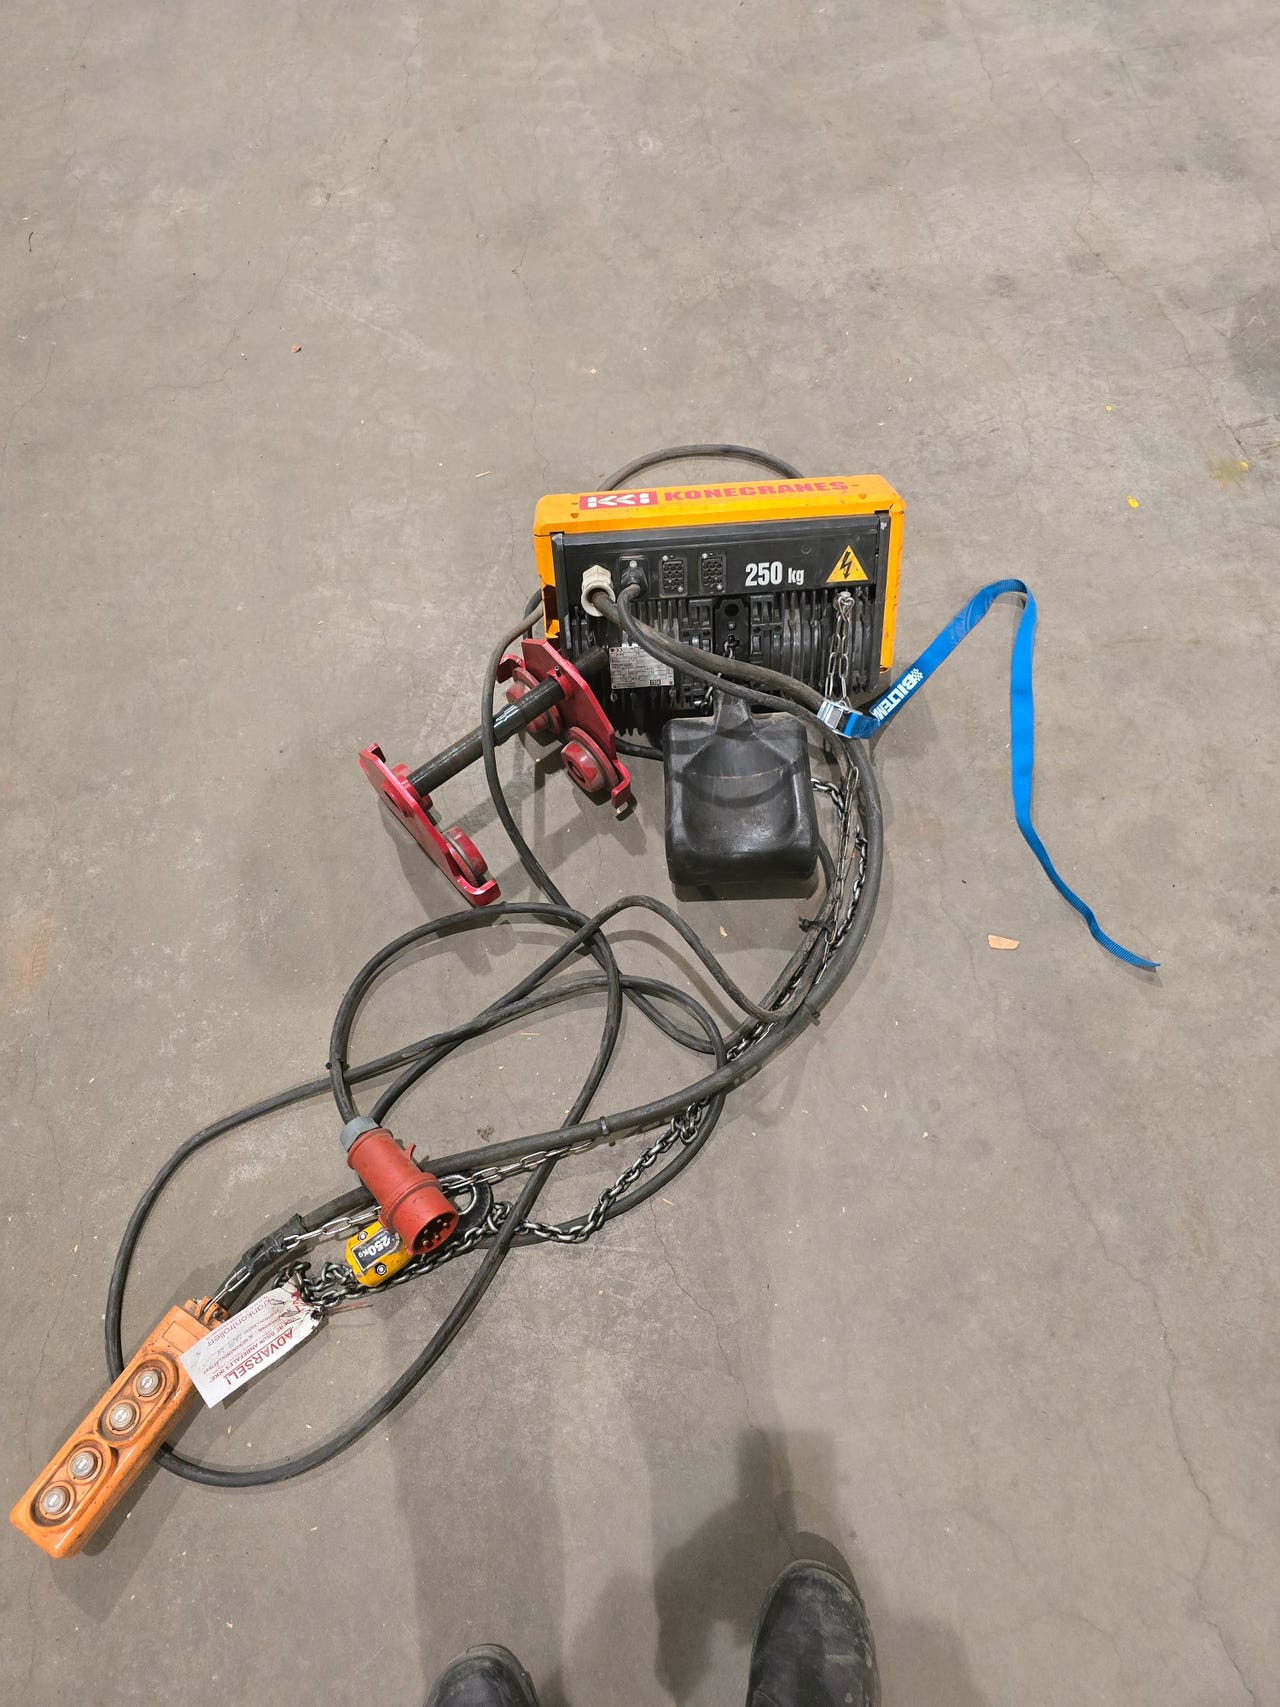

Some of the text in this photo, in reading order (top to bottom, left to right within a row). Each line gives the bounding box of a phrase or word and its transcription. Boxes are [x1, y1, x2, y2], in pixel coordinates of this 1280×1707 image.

[664, 481, 850, 501] KONECRANES
[745, 561, 805, 587] 250 kg
[224, 1328, 295, 1385] ADVARSEL!
